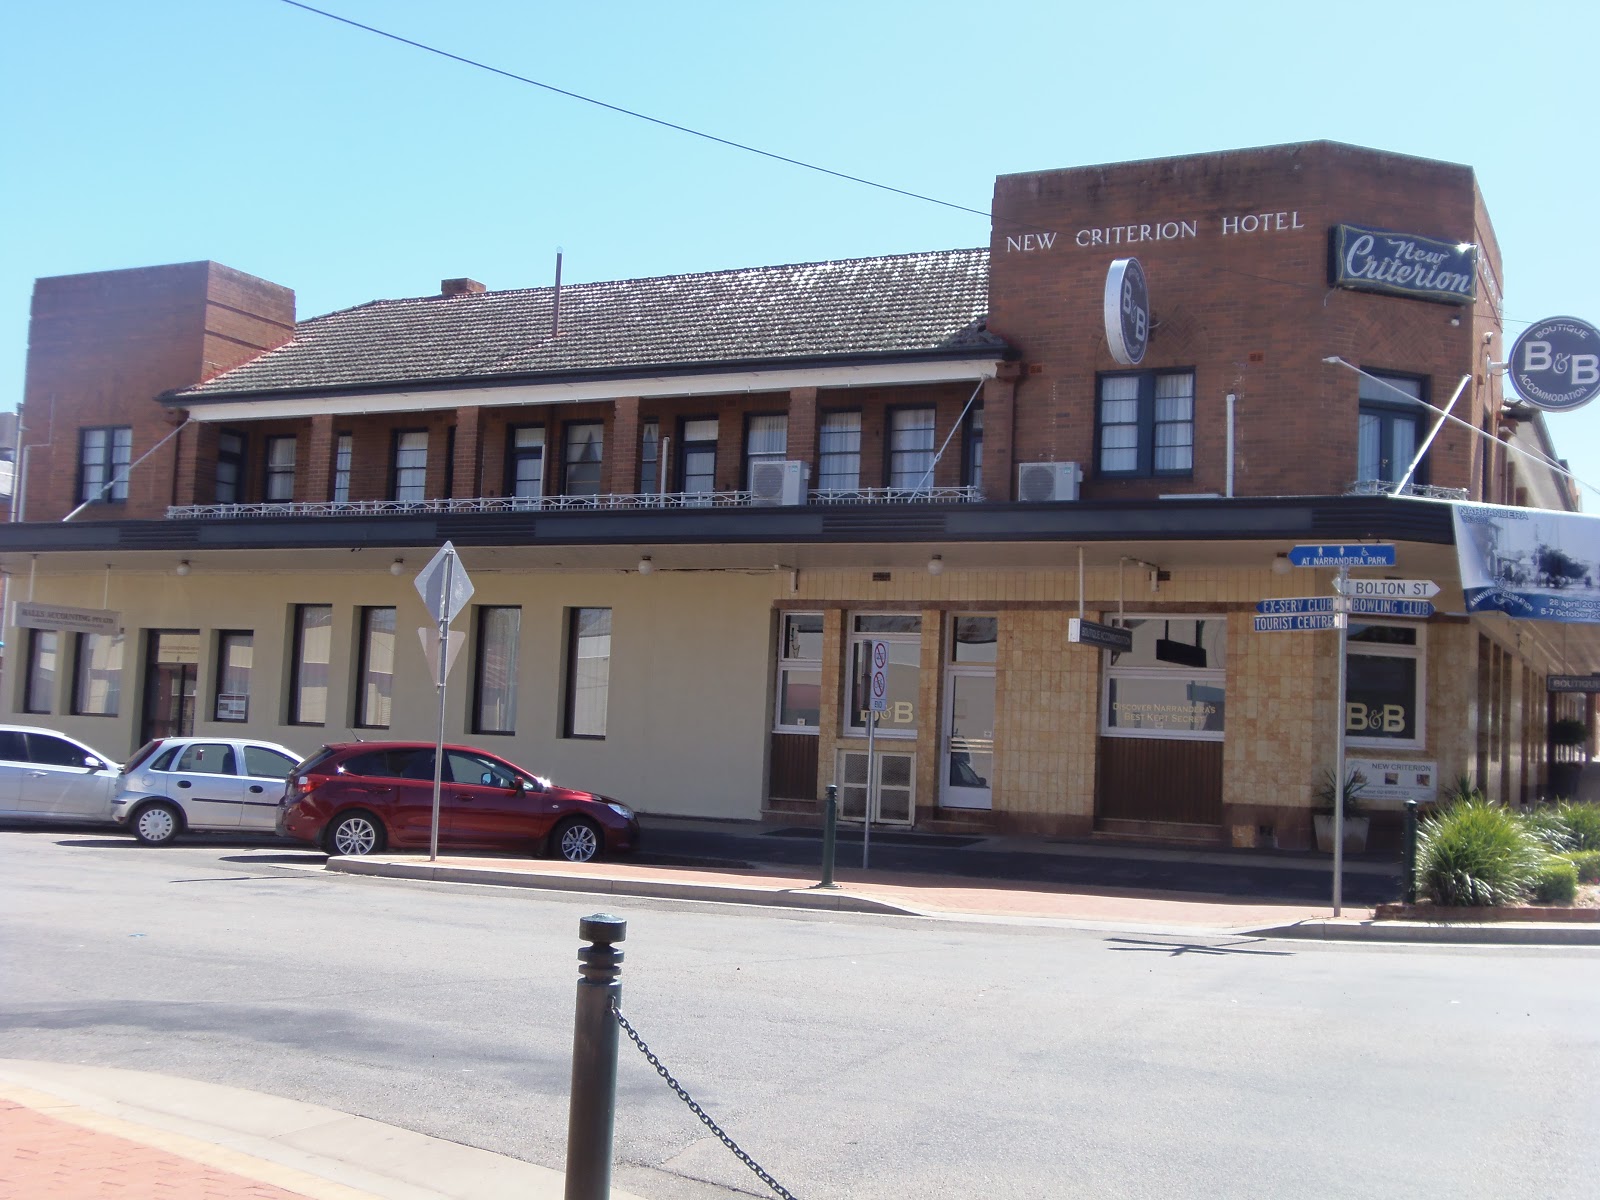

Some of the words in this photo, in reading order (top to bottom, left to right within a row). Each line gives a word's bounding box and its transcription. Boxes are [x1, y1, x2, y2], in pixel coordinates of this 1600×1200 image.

[1006, 232, 1057, 252] NEW
[1076, 220, 1198, 246] CRITERION
[1222, 211, 1305, 235] HOTEL
[1387, 238, 1450, 264] New
[1346, 234, 1471, 293] Criterion
[1534, 324, 1590, 339] BOUTIQUE
[1523, 340, 1600, 385] B&B
[1519, 374, 1588, 402] ACCOMMODATION
[1459, 506, 1529, 521] NARRANDERA
[1301, 557, 1311, 566] AT
[1313, 556, 1364, 566] NARRANDERA
[1367, 556, 1387, 565] PARK
[1355, 581, 1406, 595] BOLTON
[1413, 583, 1429, 595] ST
[1263, 600, 1307, 613] EX-SERV
[1308, 599, 1333, 611] CLUB
[1353, 599, 1398, 613] BOWLING
[1402, 602, 1429, 614] CLUB
[1561, 600, 1580, 609] April
[1556, 609, 1589, 618] October
[1255, 616, 1293, 630] TOURIST
[1297, 615, 1333, 629] CENTRE
[1346, 702, 1406, 733] B&B
[1391, 764, 1432, 772] CRITERION
